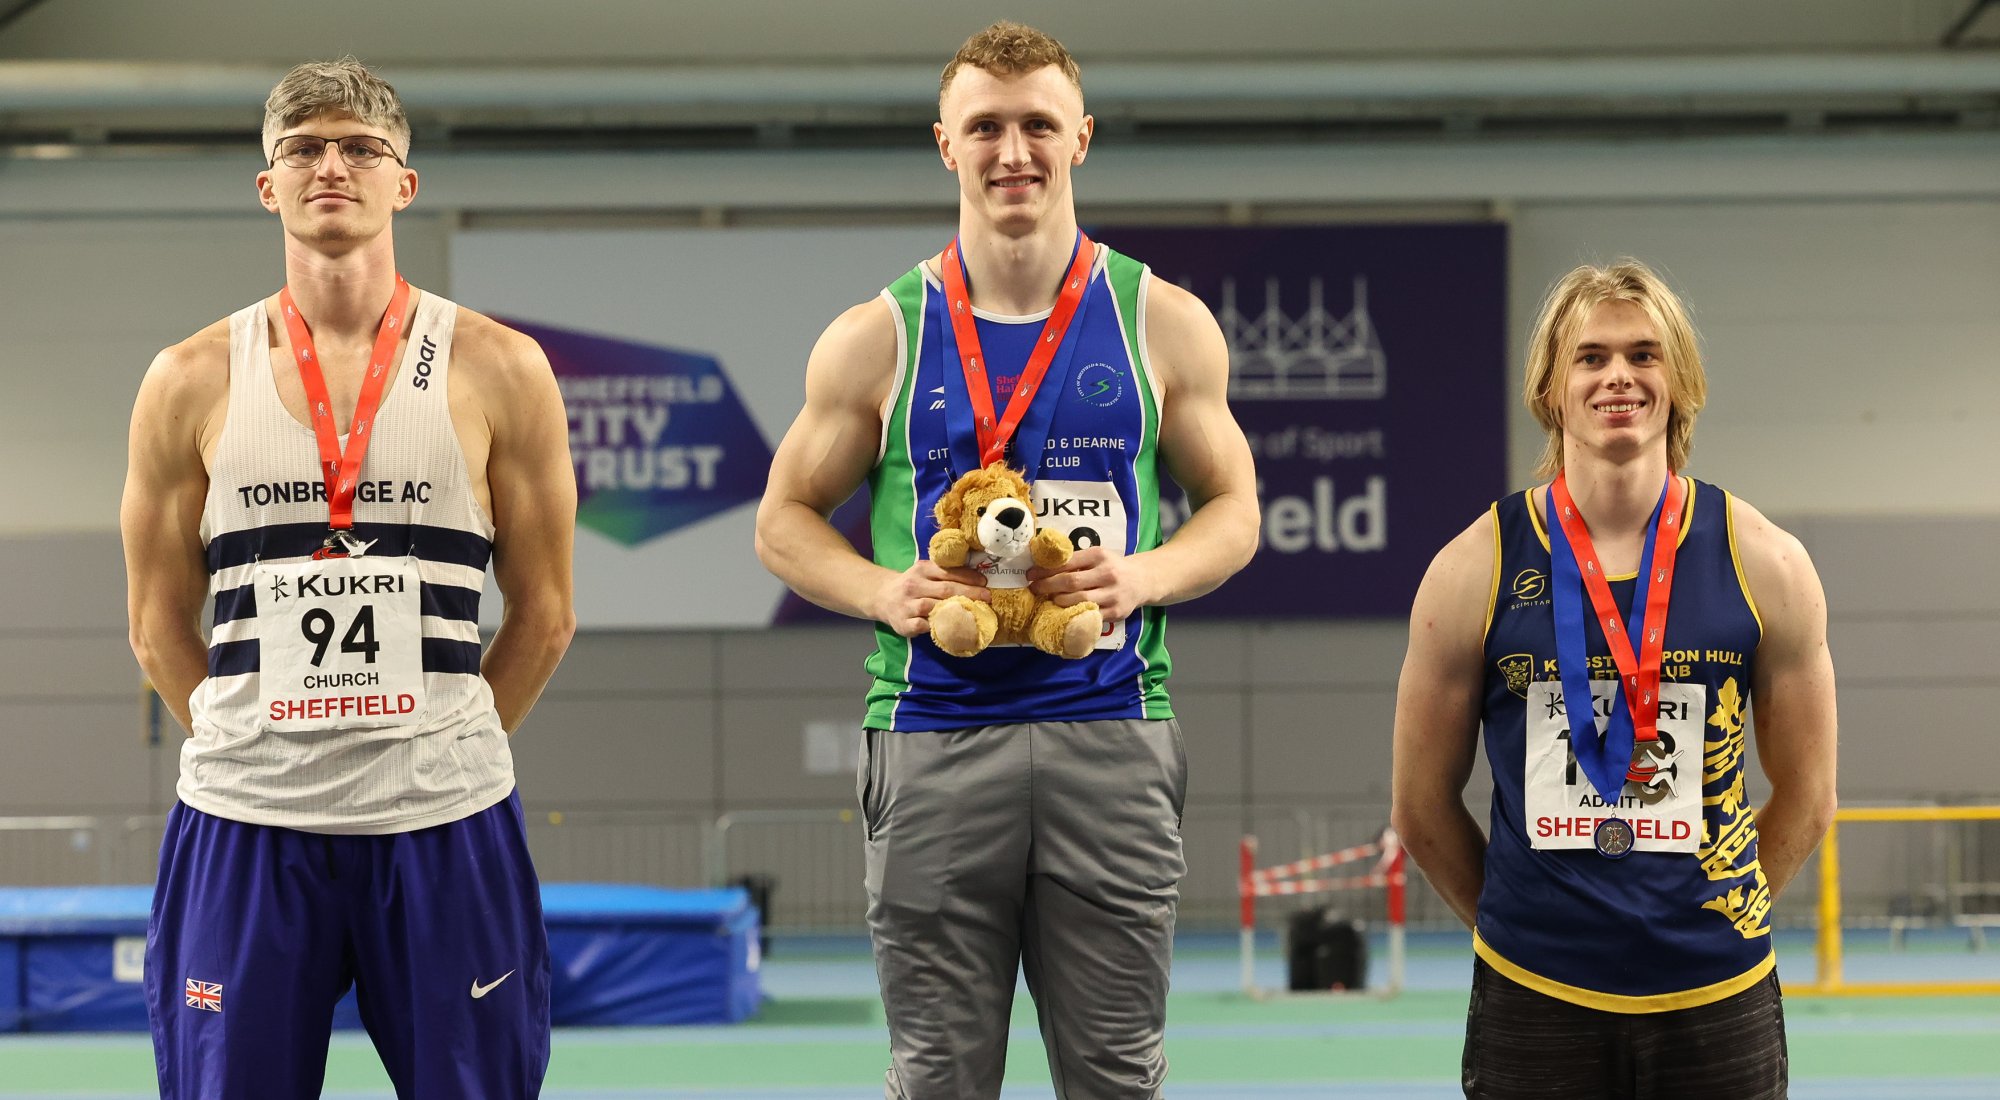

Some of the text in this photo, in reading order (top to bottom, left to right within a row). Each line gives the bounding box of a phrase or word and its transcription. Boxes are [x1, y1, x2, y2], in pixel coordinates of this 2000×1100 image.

[413, 334, 437, 391] soar
[928, 448, 948, 460] CIT
[1060, 438, 1069, 449] &
[1073, 437, 1125, 450] DEARNE
[1046, 456, 1080, 468] CLUB
[238, 480, 432, 508] TONBRGE AC
[1031, 498, 1111, 518] UKRI
[298, 574, 405, 598] KUKRI
[1511, 599, 1551, 610] SCIMITAR
[301, 605, 380, 668] 94
[1661, 649, 1700, 664] PON
[1705, 650, 1743, 666] HULL
[303, 672, 380, 689] CHURCH
[269, 694, 416, 721] SHEFFIELD
[1591, 694, 1689, 721] KURI
[1536, 816, 1691, 841] SHEELD
